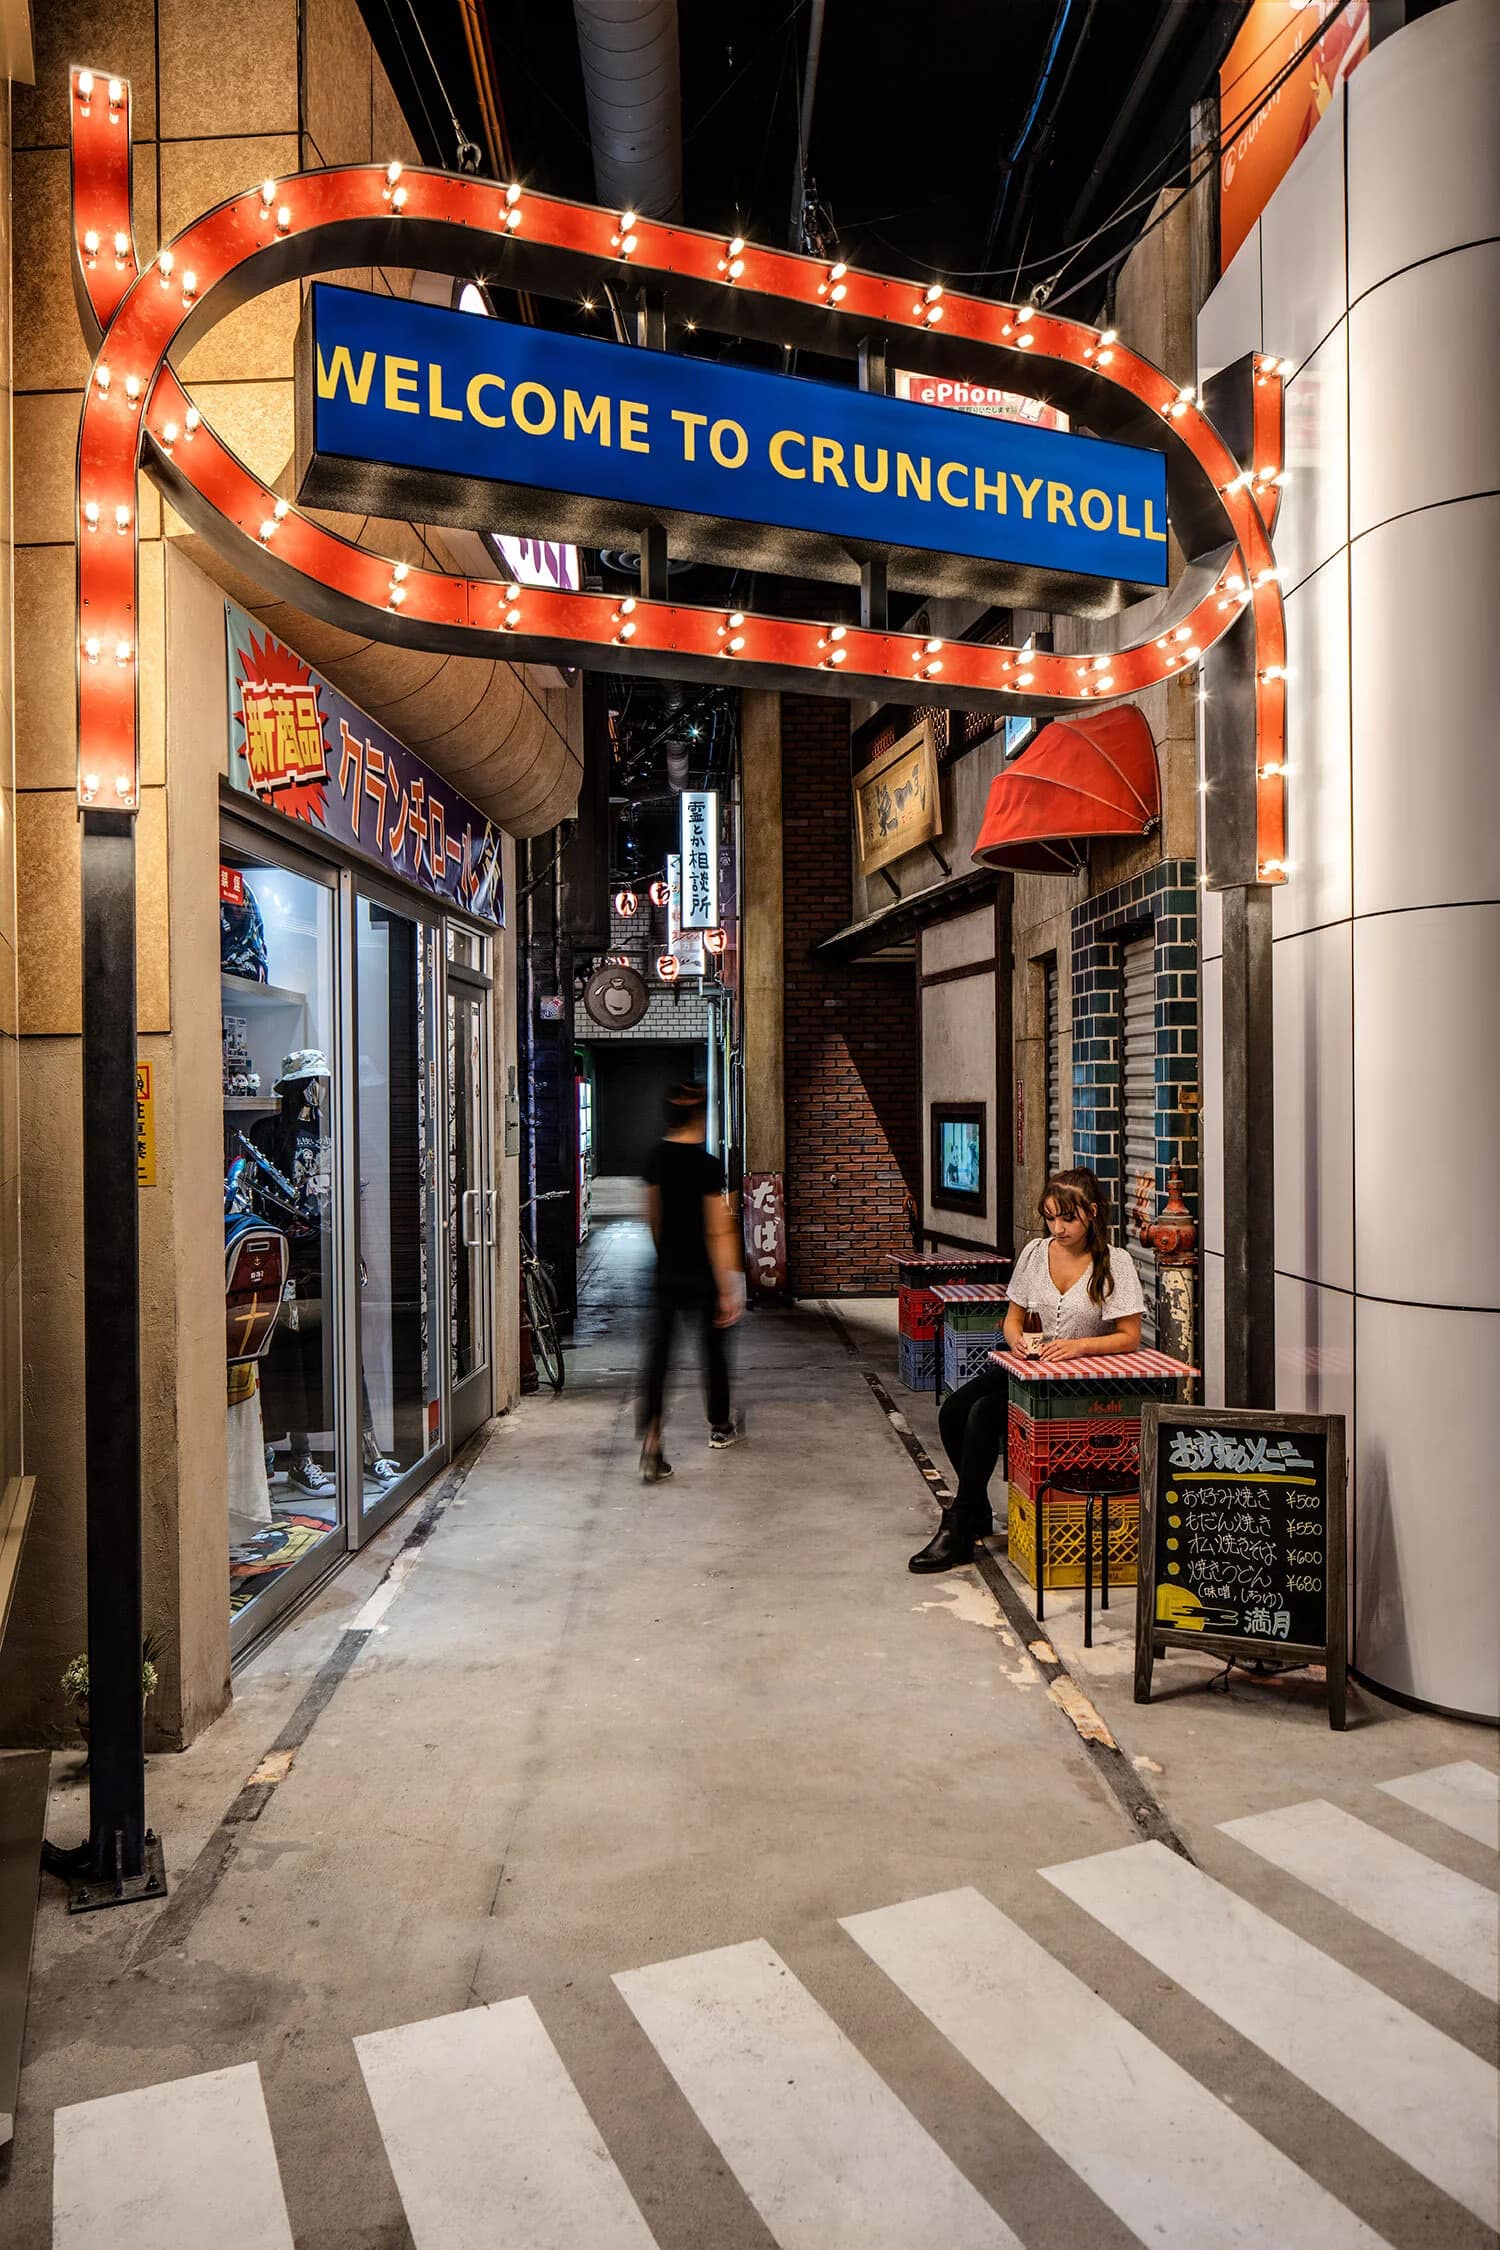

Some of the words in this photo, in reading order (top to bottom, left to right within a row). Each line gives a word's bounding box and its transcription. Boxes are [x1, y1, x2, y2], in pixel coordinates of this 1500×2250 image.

[317, 342, 651, 454] WELCOME
[671, 410, 749, 469] TO
[768, 429, 1167, 542] CRUNCHYROLL
[247, 694, 322, 774] 新商品
[338, 717, 480, 897] クランチロール
[687, 800, 712, 920] 霊とか相談所
[751, 1181, 781, 1288] たばこ
[1181, 1486, 1272, 1510] お好み焼き
[1286, 1490, 1321, 1510] ¥500
[1185, 1511, 1272, 1537] もだん焼き
[1286, 1518, 1323, 1539] ¥550
[1187, 1558, 1273, 1589] 焼きうどん
[1286, 1574, 1323, 1593] ¥680
[1286, 1549, 1323, 1567] ¥600
[1243, 1606, 1292, 1640] 満月
